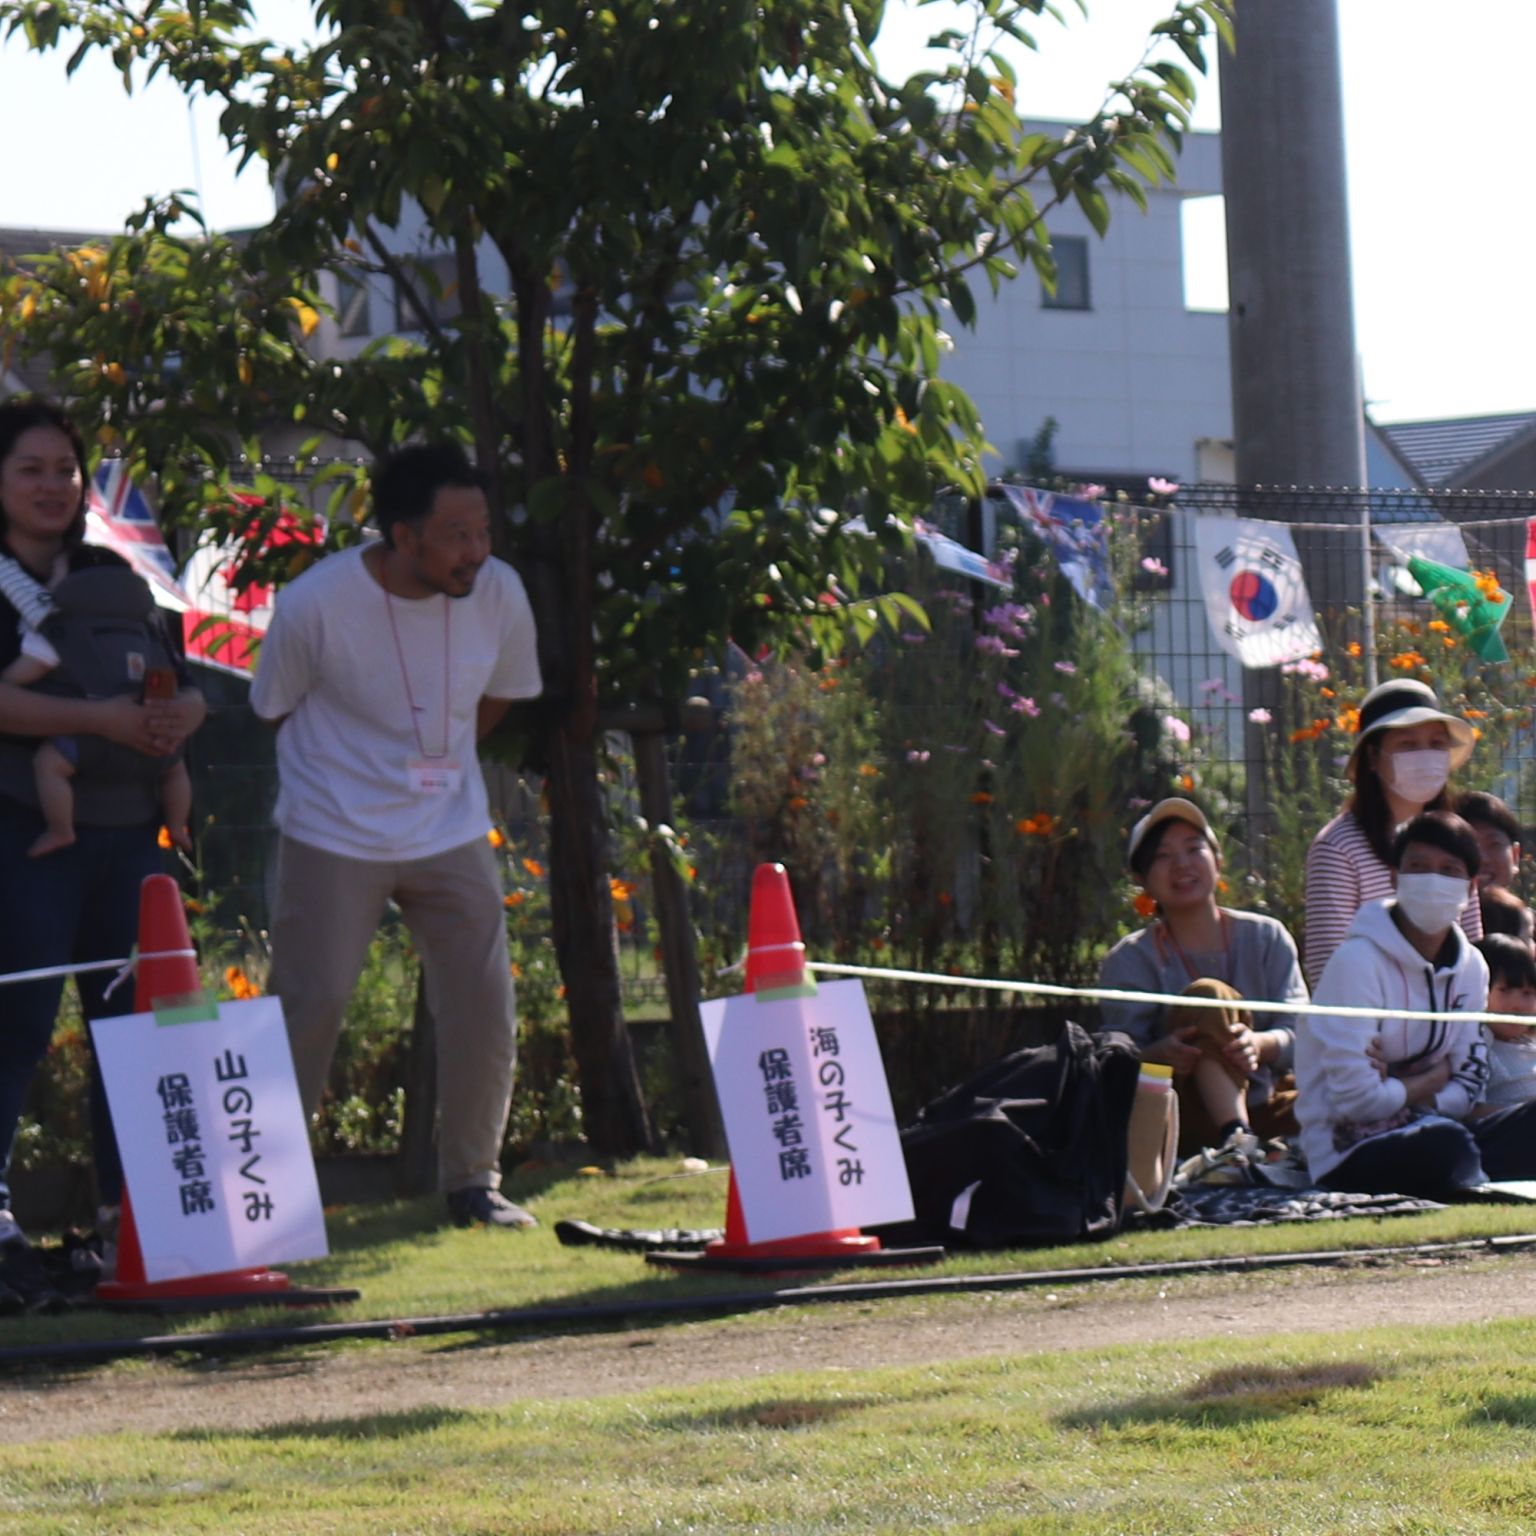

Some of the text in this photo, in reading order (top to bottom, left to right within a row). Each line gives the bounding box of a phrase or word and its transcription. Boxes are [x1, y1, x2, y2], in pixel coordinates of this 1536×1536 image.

[156, 1072, 215, 1216] 保護者席
[214, 1049, 275, 1222] 山の子くみ
[758, 1048, 812, 1181] 保護者席
[809, 1026, 865, 1186] 海の子くみ
